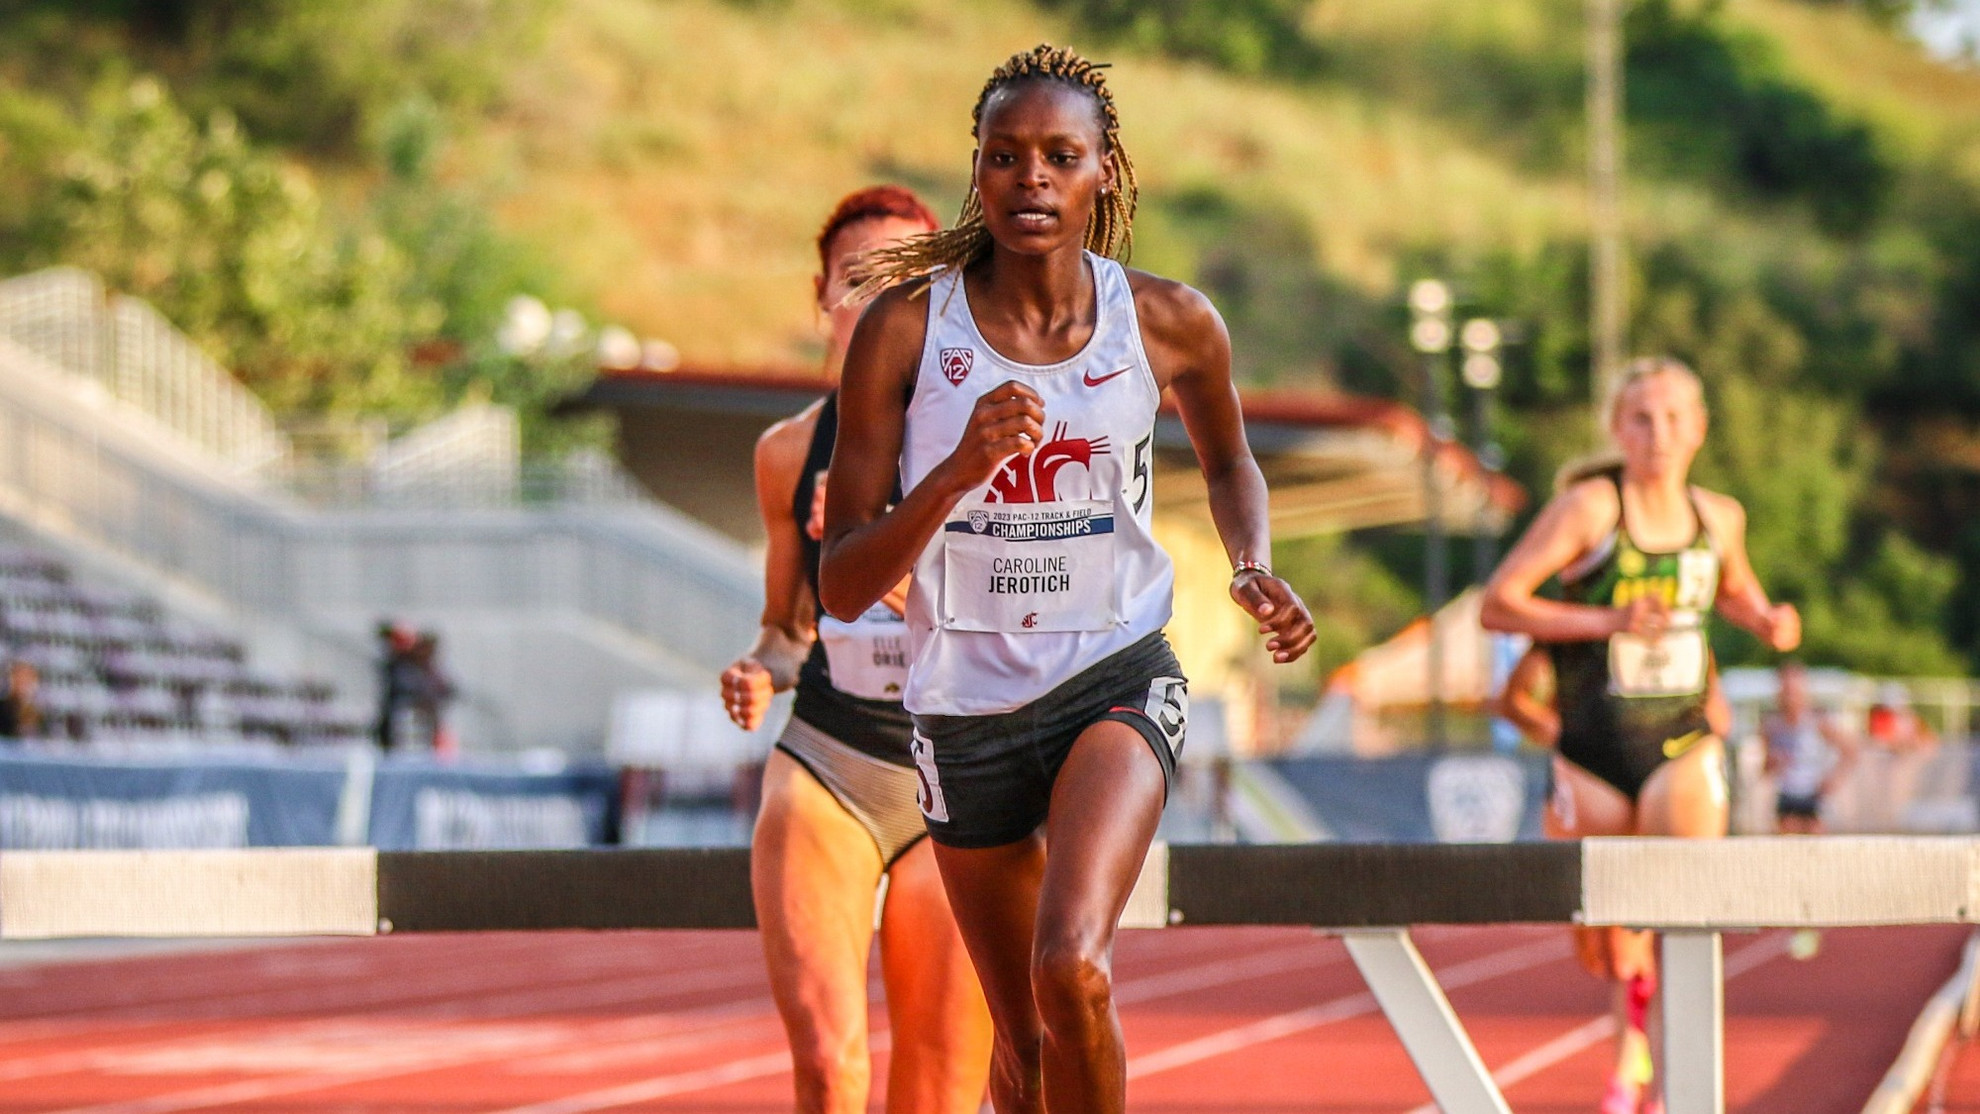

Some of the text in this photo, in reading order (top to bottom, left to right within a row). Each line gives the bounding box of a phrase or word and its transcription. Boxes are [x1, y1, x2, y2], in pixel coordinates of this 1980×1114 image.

[941, 349, 972, 371] PAC
[948, 364, 965, 380] 12
[1132, 432, 1148, 515] 5
[993, 508, 1092, 521] 2023 PAC-12 TRACK & FIELD
[992, 519, 1092, 538] CHAMPIONSHIPS
[993, 556, 1067, 574] CAROLINE
[988, 574, 1070, 594] JEROTICH
